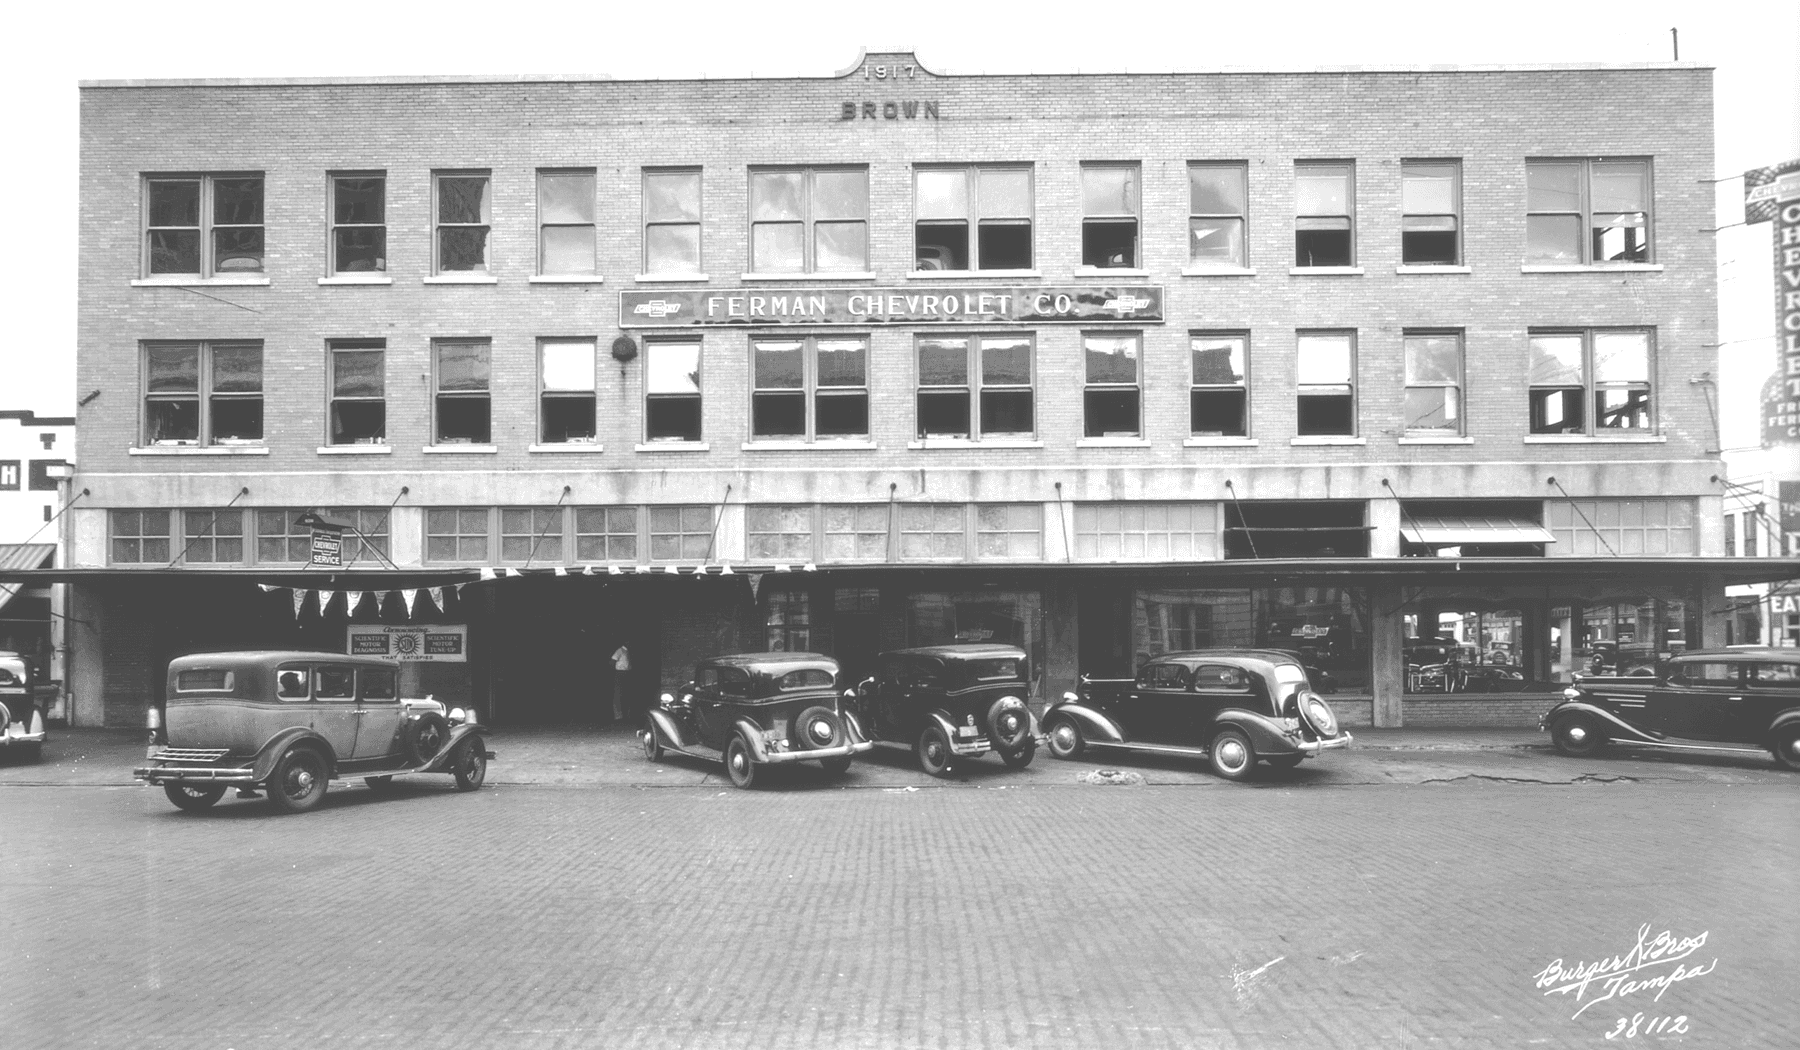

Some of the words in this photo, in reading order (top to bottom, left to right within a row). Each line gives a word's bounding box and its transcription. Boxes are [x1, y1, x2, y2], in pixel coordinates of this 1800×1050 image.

[864, 65, 916, 79] 1917
[842, 101, 939, 120] BROWN
[708, 296, 826, 317] FERMAN
[848, 294, 1012, 316] CHEVROLET
[1034, 294, 1080, 314] CO.
[1777, 402, 1800, 414] FR
[1768, 414, 1800, 427] FER
[313, 555, 340, 565] SERVICE
